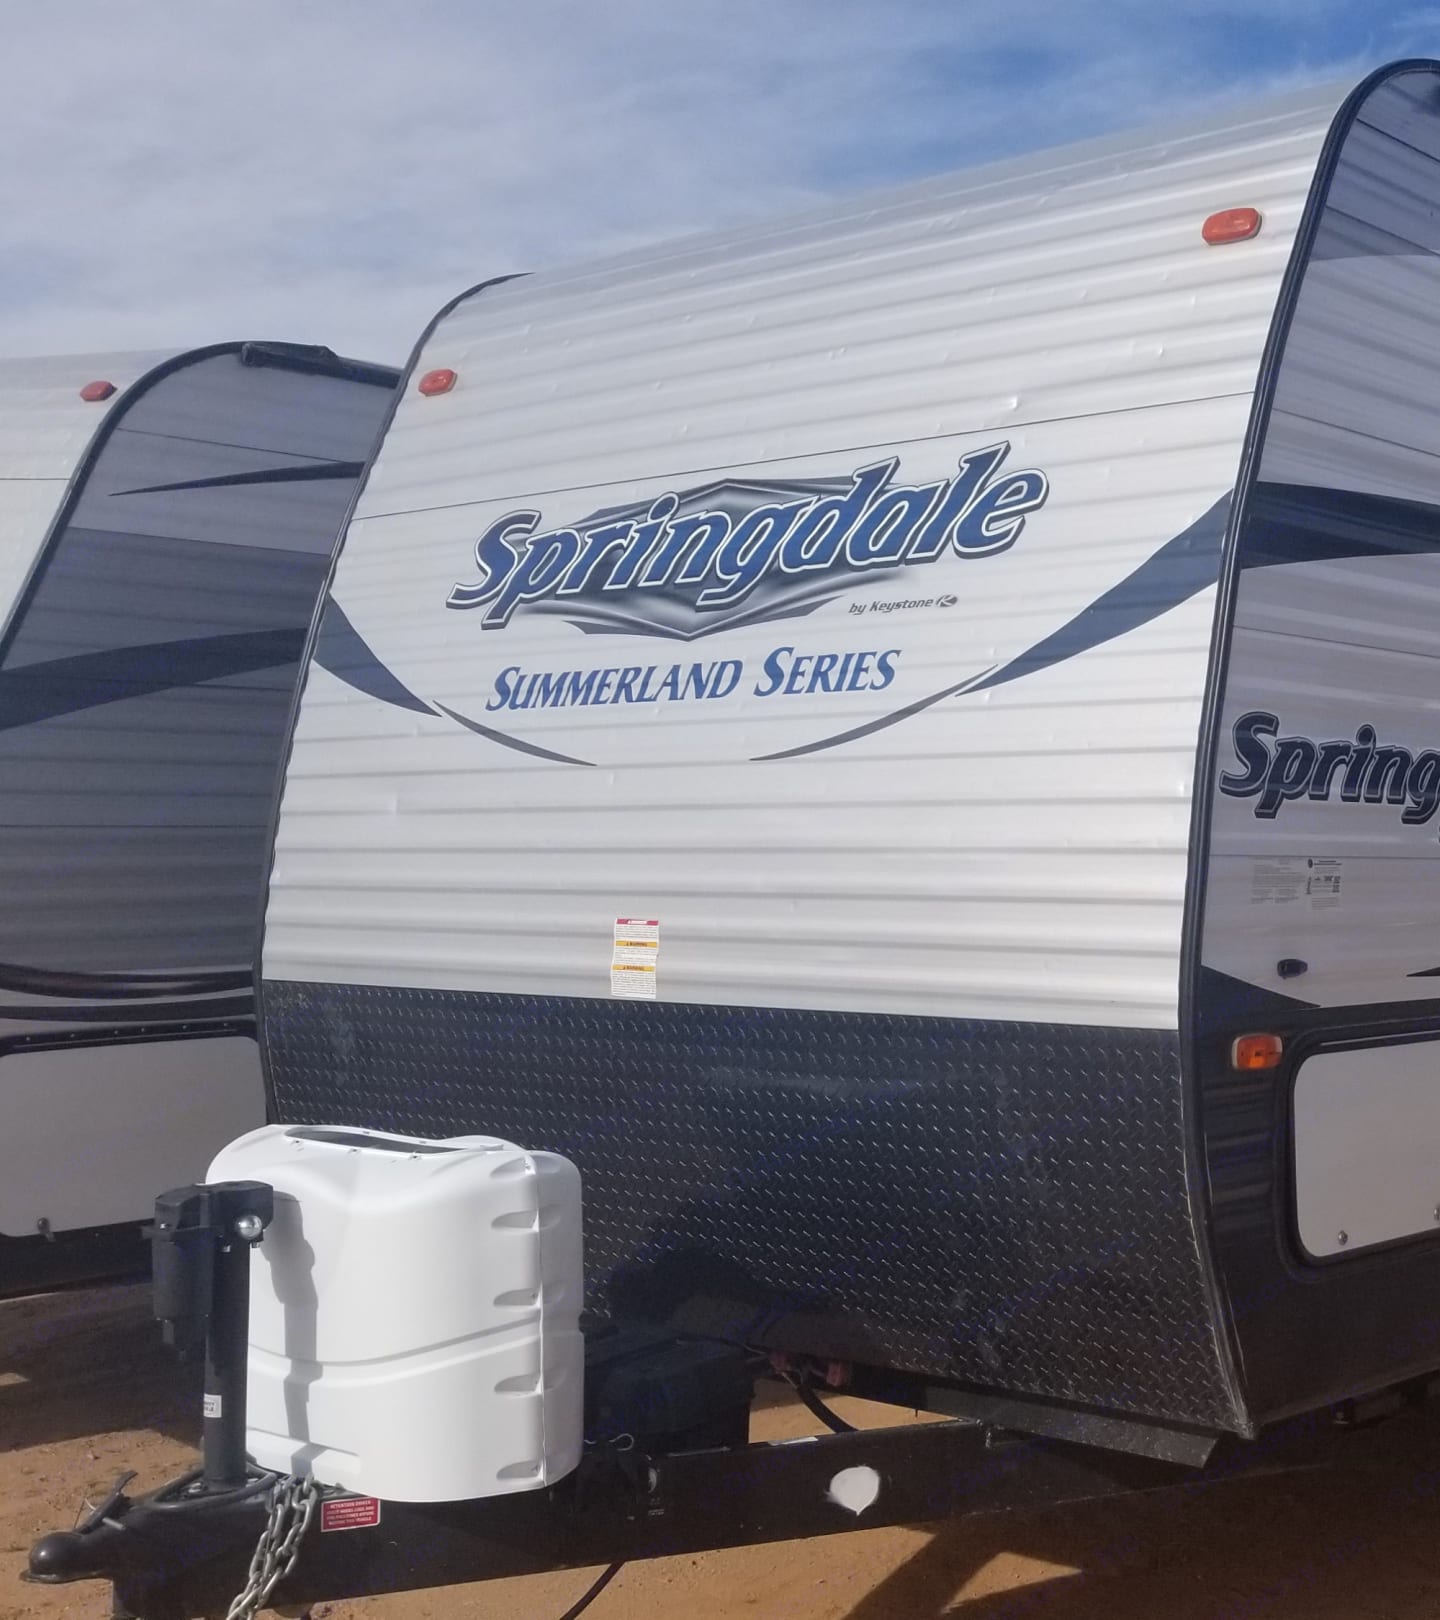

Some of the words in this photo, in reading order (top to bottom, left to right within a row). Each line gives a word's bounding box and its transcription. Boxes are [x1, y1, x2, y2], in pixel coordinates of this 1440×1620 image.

[446, 440, 1050, 631] Springdale
[848, 602, 867, 616] by
[869, 598, 935, 614] Keystone
[485, 656, 743, 713] SUMMERLAND
[752, 646, 902, 697] SERIES
